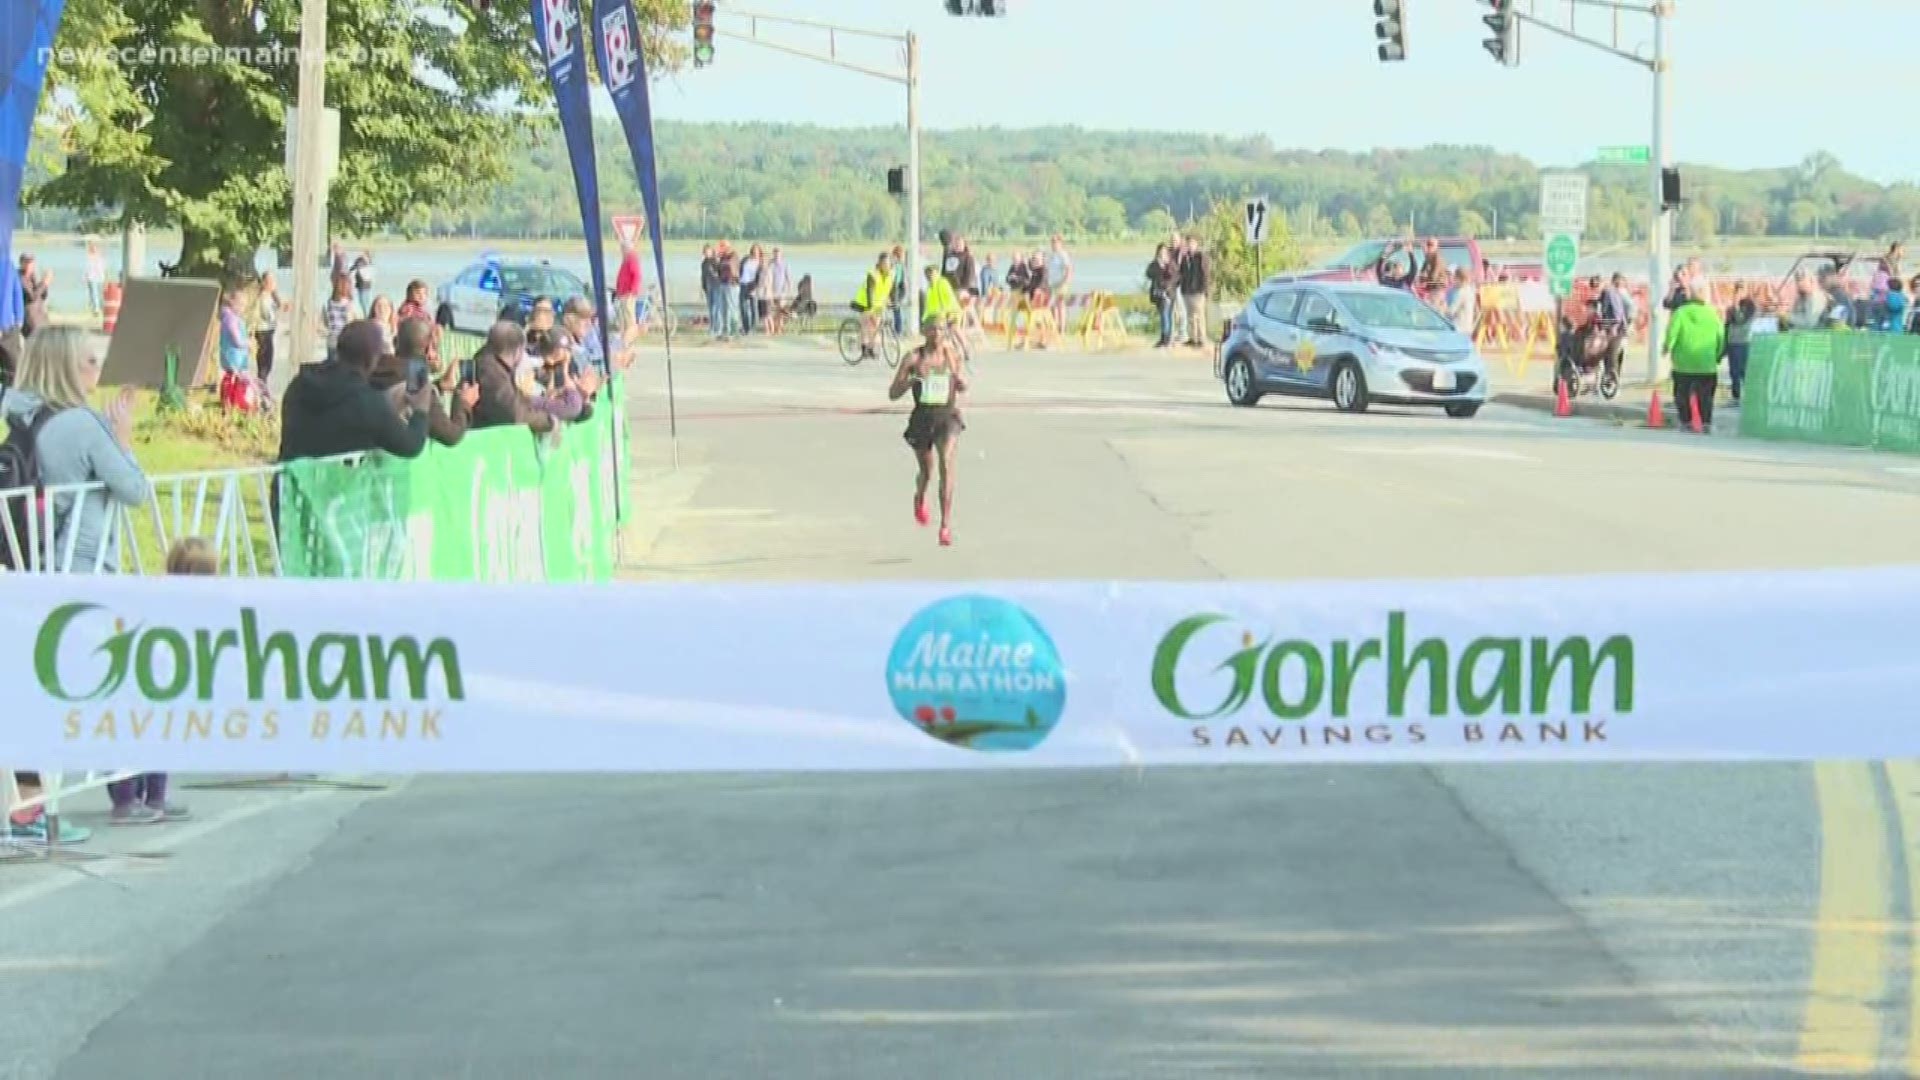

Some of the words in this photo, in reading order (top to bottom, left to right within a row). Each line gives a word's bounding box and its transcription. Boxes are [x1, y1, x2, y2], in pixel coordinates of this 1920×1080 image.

[34, 602, 465, 701] Gorham
[907, 629, 1034, 668] Maine
[1151, 610, 1635, 719] Gorham
[894, 671, 1056, 690] MARATHON
[64, 708, 281, 741] SAVINGS
[311, 708, 443, 739] BANK
[1192, 725, 1427, 746] SAVINGS
[1464, 720, 1608, 743] BANK
